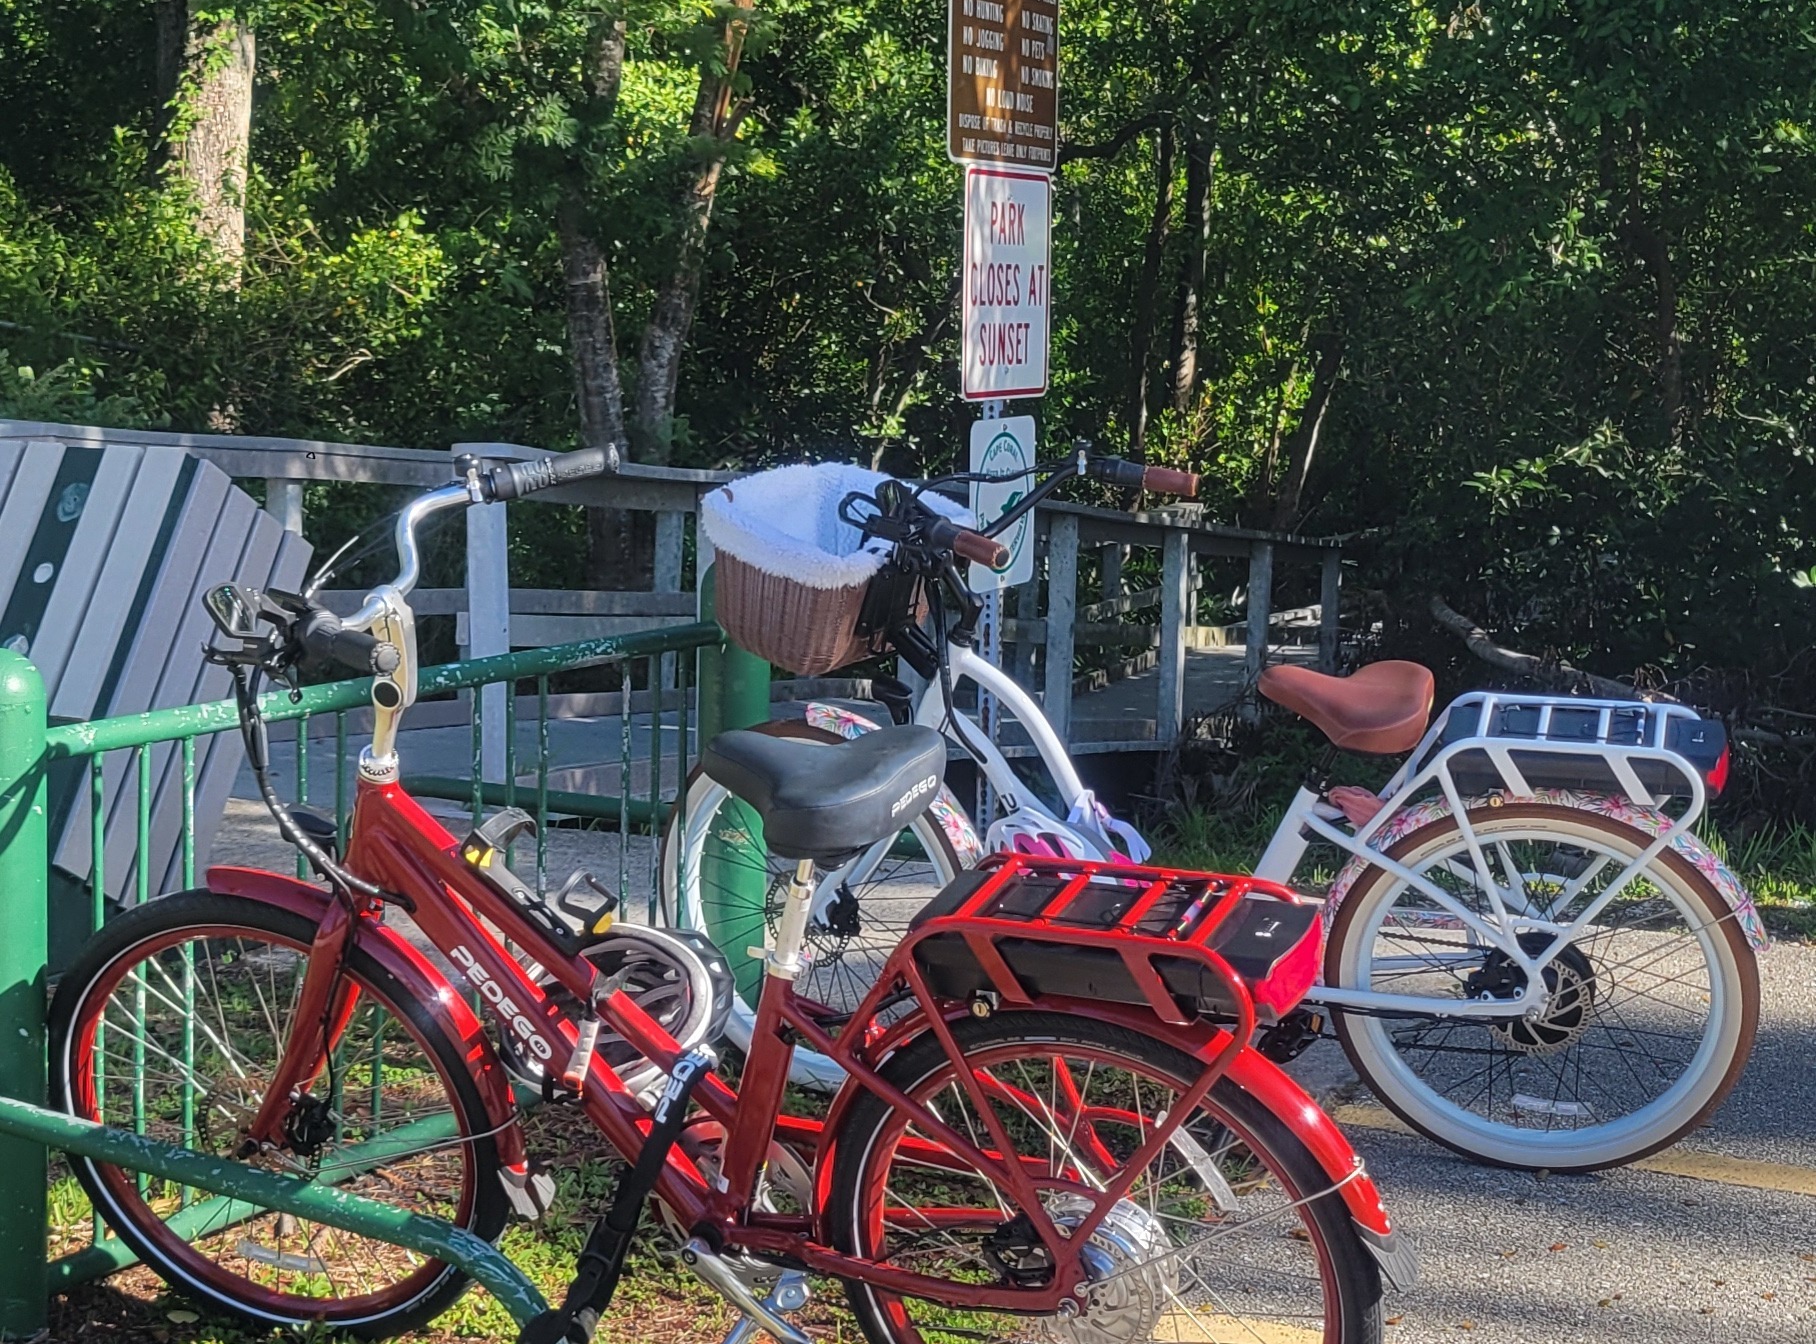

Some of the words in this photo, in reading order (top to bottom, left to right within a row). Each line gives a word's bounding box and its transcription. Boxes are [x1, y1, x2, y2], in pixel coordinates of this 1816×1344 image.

[976, 0, 1003, 23] HUNTING
[1021, 9, 1030, 29] NO
[1032, 12, 1053, 35] SKATING
[963, 25, 973, 46] NO
[976, 28, 1003, 51] JOGGING
[1021, 37, 1030, 57] NO
[1031, 40, 1045, 61] PETS
[962, 54, 973, 75] NO
[975, 56, 997, 79] BIKING
[1021, 65, 1029, 85] NO
[1031, 67, 1053, 90] SMOKING
[986, 87, 995, 107] NO
[997, 88, 1014, 110] LOUD
[1016, 92, 1034, 114] NOISE
[959, 113, 980, 130] DISPOSE
[962, 137, 975, 153] TAKE
[976, 139, 1000, 156] PICTURES
[990, 201, 1025, 246] PARK
[970, 262, 1020, 307] CLOSES
[1028, 264, 1044, 306] AT
[979, 322, 1030, 366] SUNSET
[891, 775, 936, 818] PEDEGO
[450, 945, 552, 1059] PEDEGO
